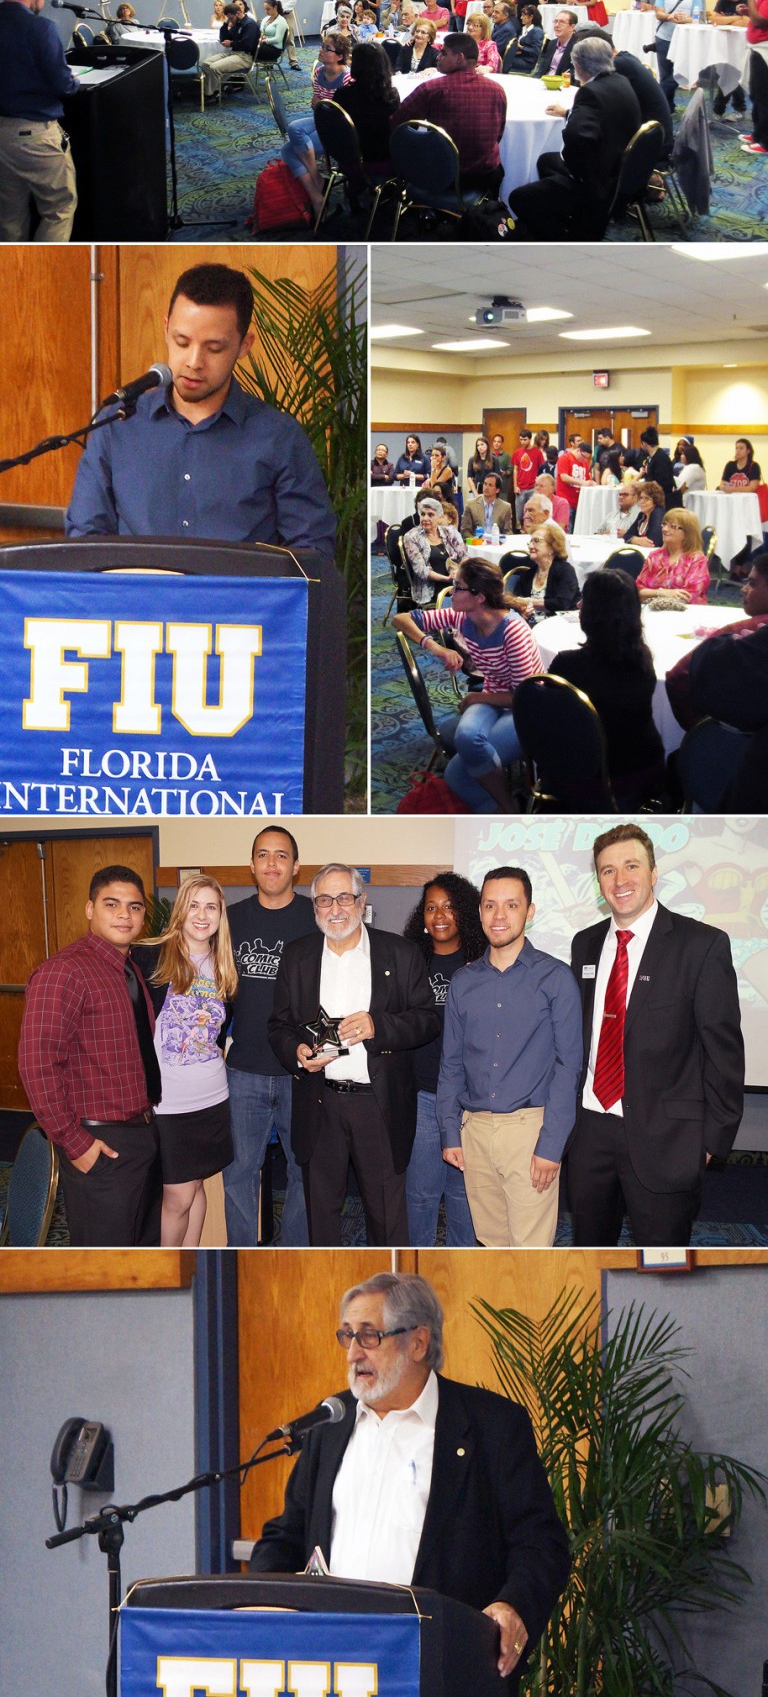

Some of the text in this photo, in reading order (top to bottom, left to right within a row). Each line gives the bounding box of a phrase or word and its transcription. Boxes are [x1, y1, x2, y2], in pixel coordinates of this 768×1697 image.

[22, 617, 262, 737] FIU
[60, 748, 221, 782] FLORIDA
[0, 781, 294, 815] NTERNATIONAL
[241, 953, 281, 966] COMIC
[248, 965, 278, 975] CLUB
[660, 1252, 669, 1262] 95
